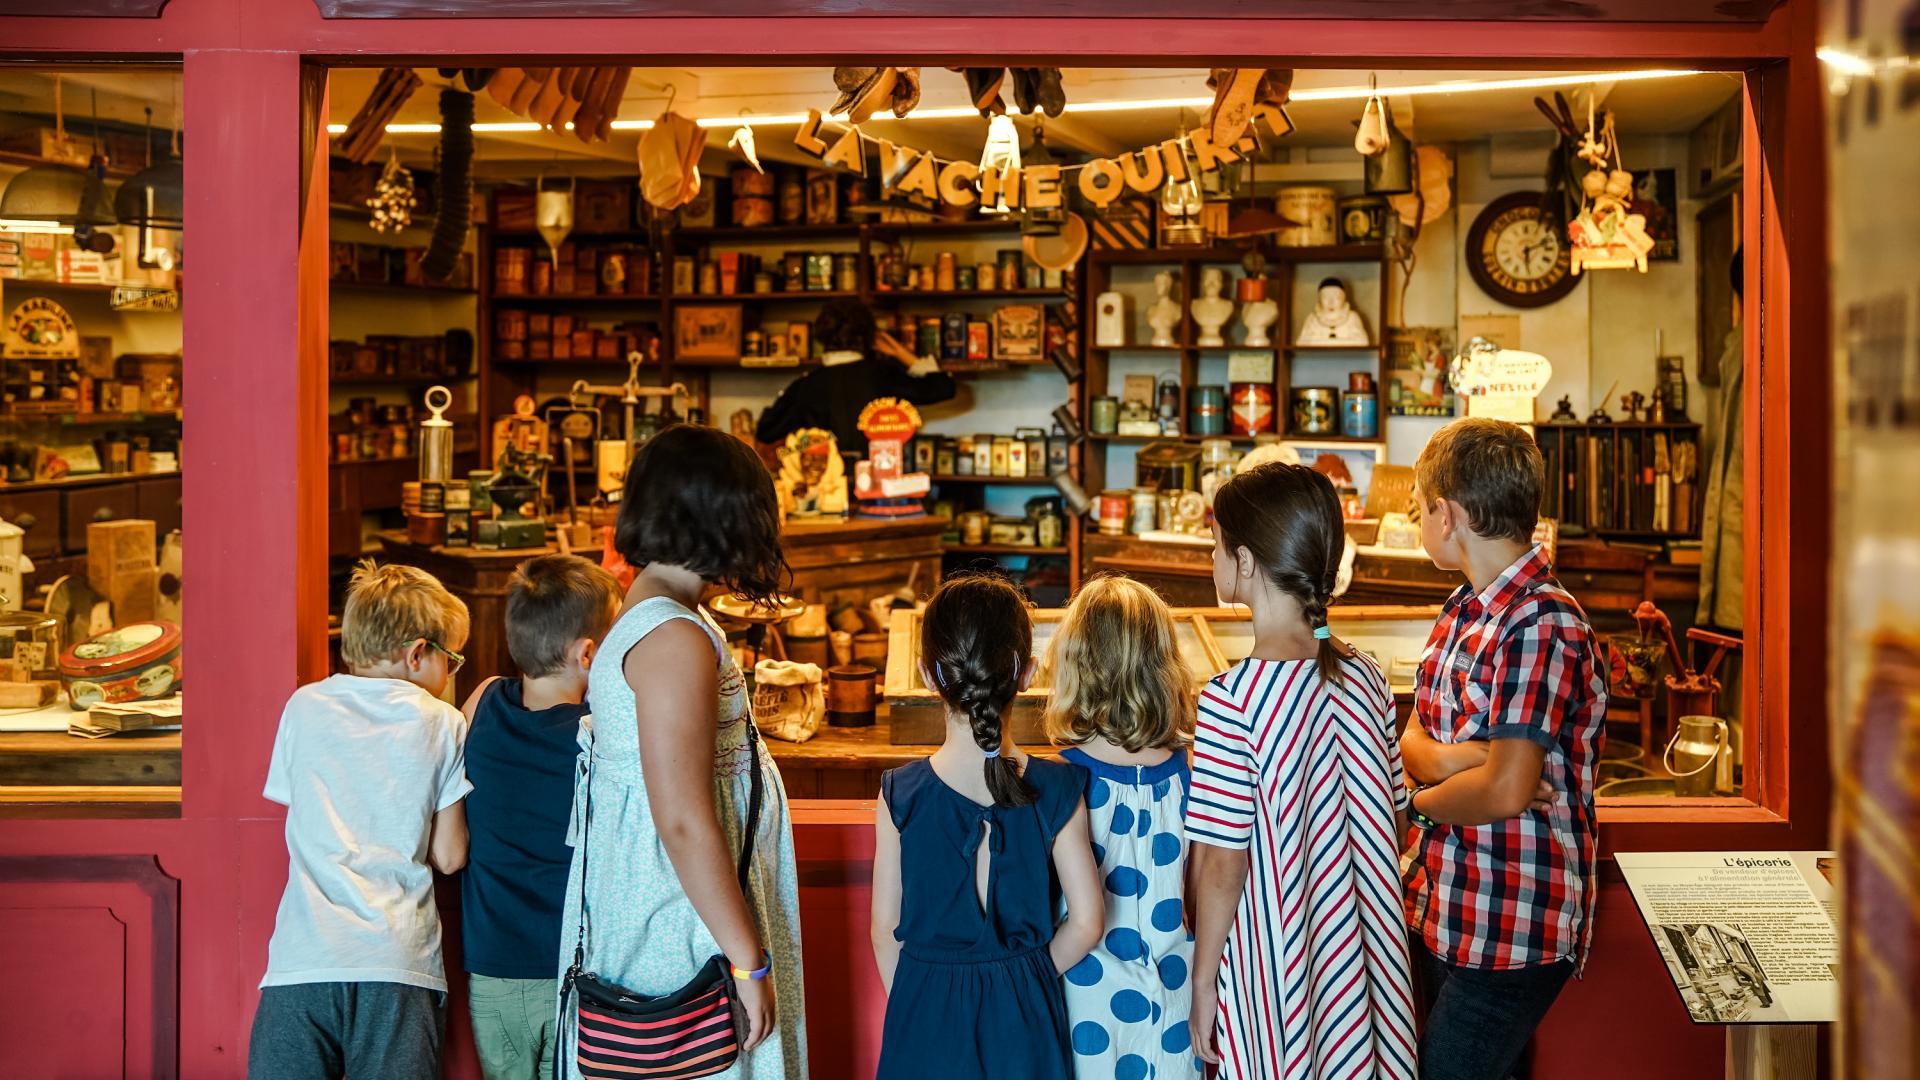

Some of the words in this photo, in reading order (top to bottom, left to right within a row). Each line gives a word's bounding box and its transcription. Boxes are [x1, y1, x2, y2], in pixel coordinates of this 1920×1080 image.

[793, 108, 868, 179] LA
[877, 137, 1062, 209] VACHE
[1079, 138, 1190, 209] QUI
[1723, 857, 1792, 869] L'épicerie
